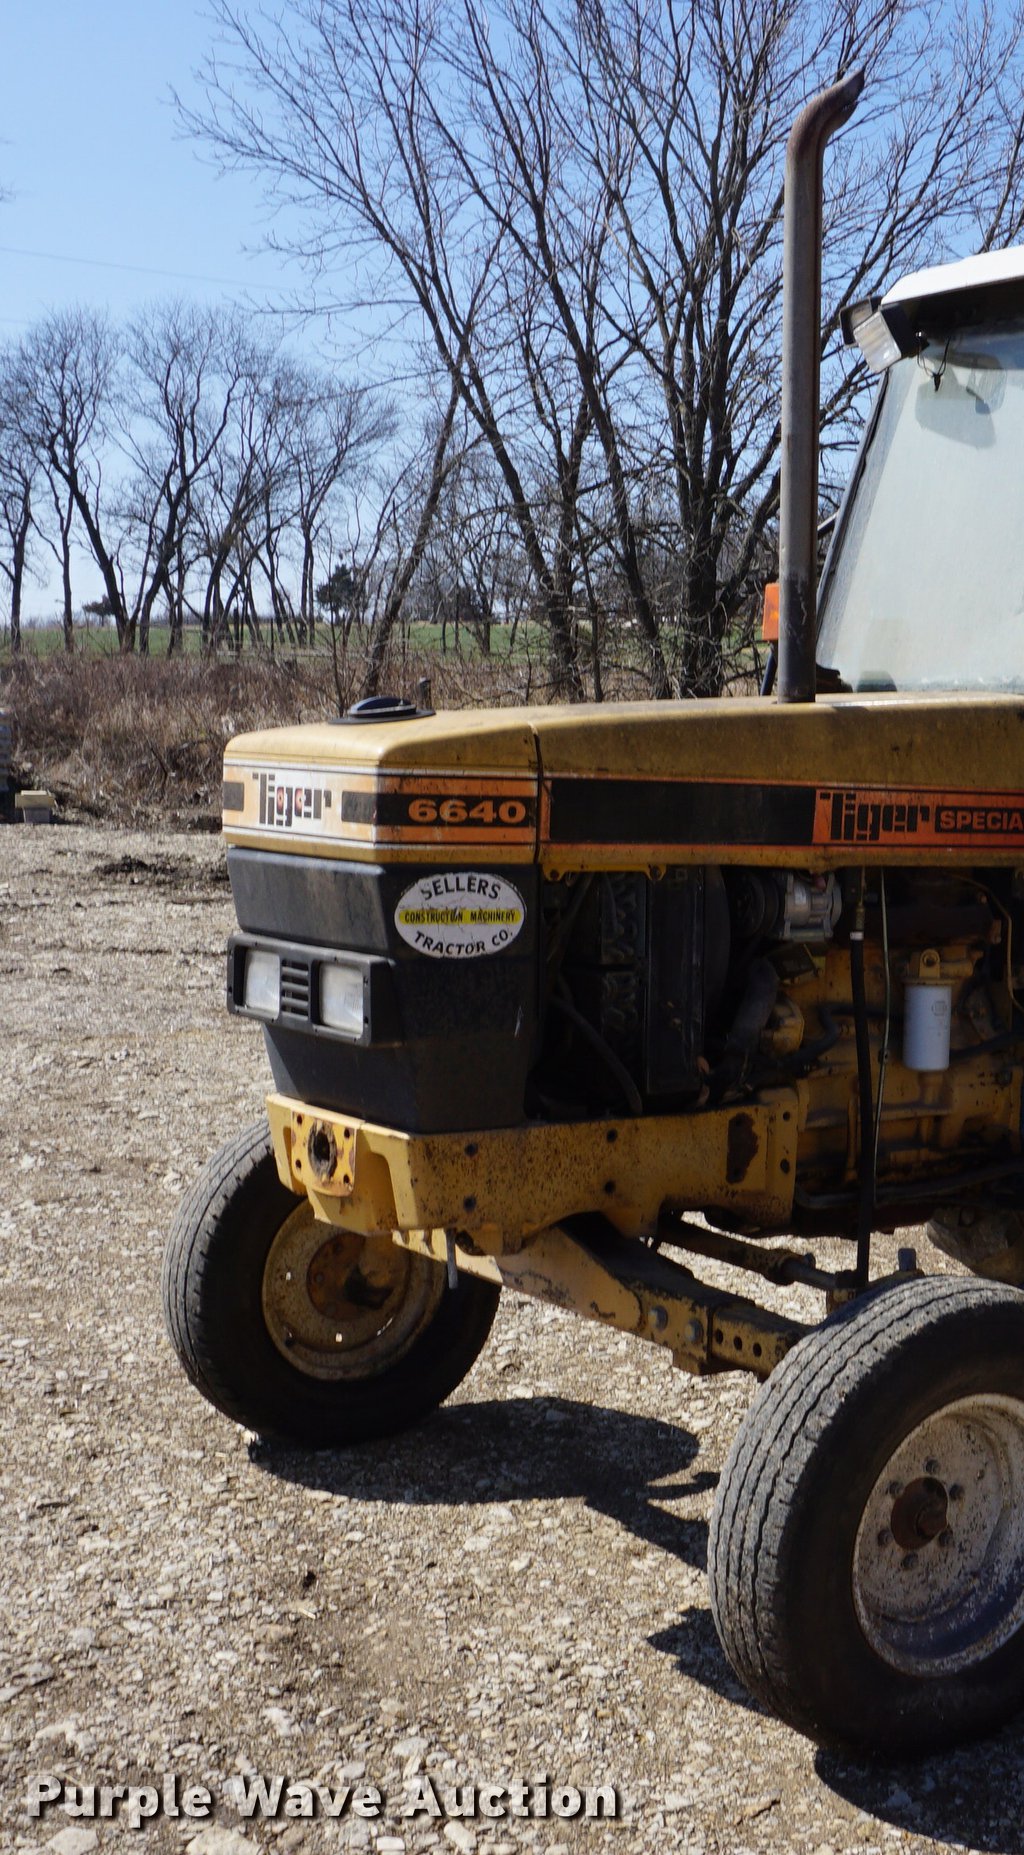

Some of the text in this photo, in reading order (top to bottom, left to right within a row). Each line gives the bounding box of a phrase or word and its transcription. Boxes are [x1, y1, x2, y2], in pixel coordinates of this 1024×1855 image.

[408, 799, 527, 823] 6640
[420, 876, 501, 901] SELLERS
[470, 908, 516, 923] MACHINERY
[414, 929, 514, 955] TRACTOR CO.
